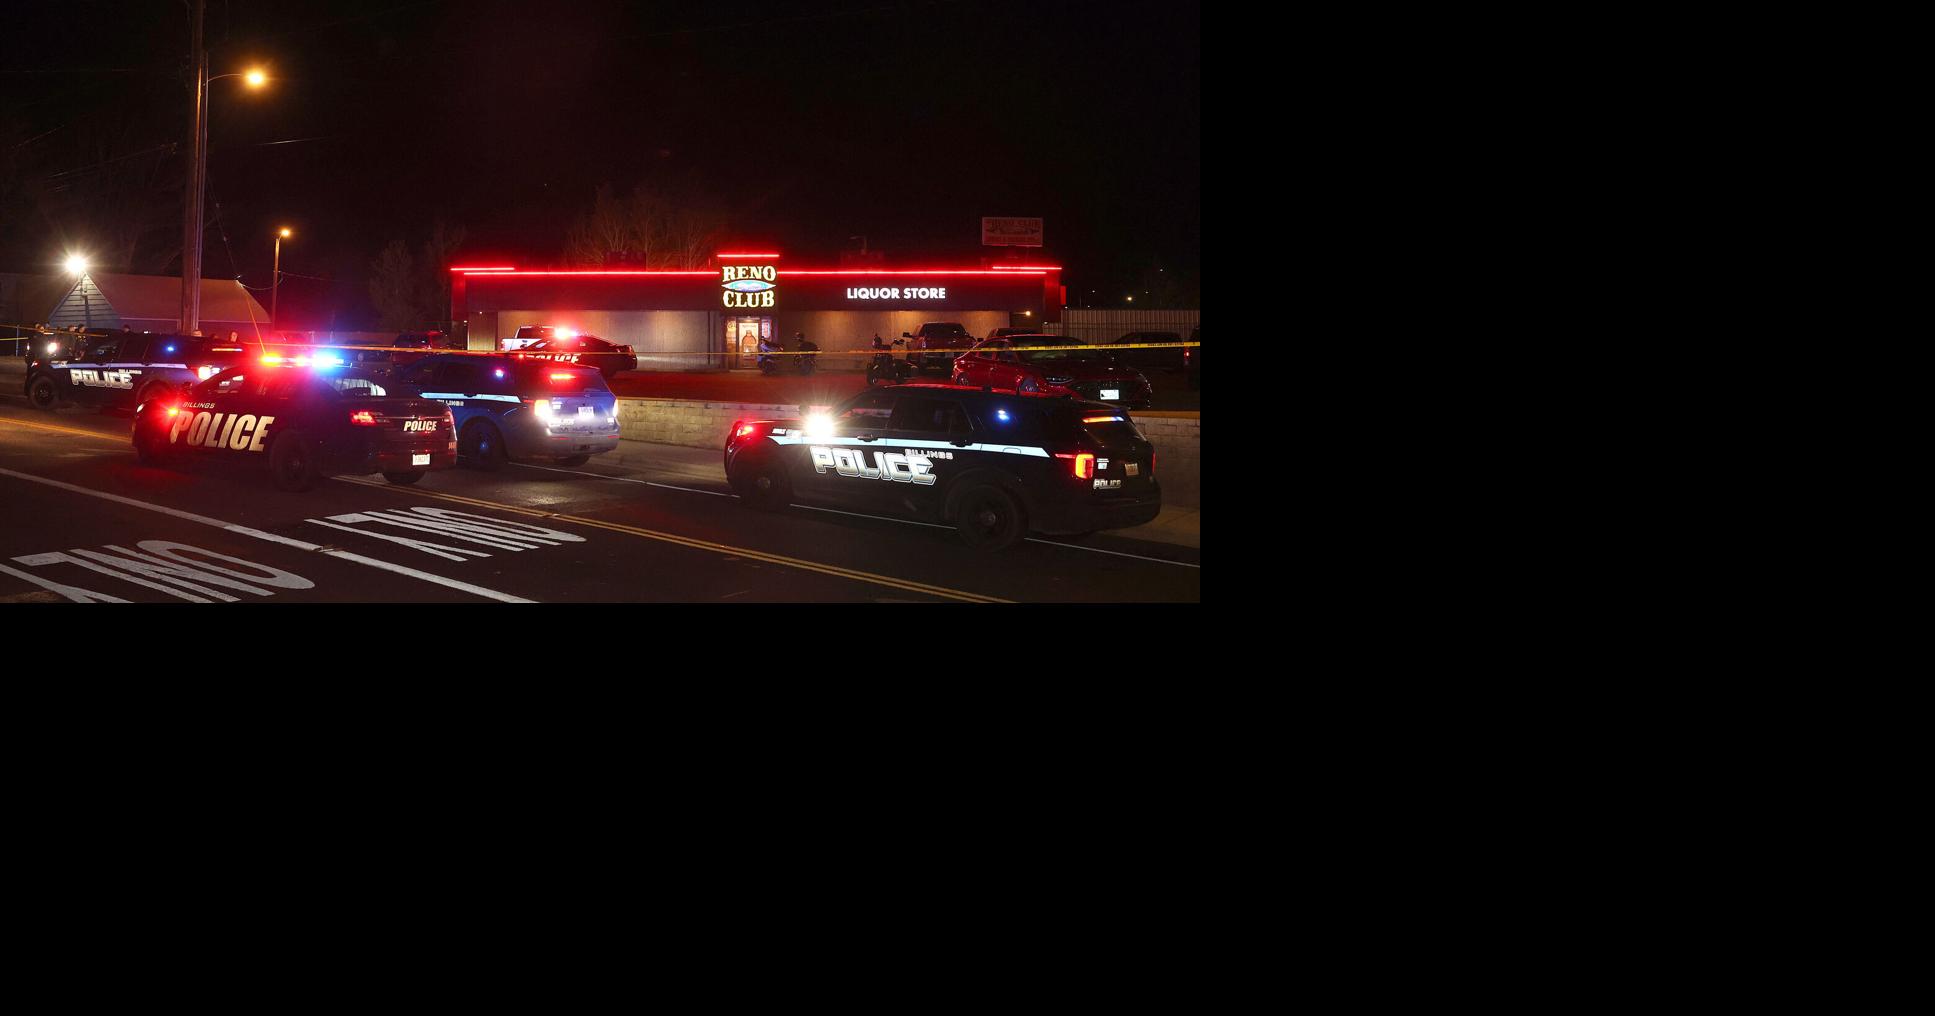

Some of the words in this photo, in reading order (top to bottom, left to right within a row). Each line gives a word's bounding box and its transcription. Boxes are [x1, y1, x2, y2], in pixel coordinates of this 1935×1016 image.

[722, 265, 776, 282] RENO
[723, 290, 775, 308] CLUB
[847, 287, 900, 300] LIQUOR
[903, 287, 946, 300] STORE
[70, 369, 134, 389] POLICE
[169, 410, 275, 452] POLICE
[403, 420, 437, 432] POLICE
[809, 446, 937, 486] POLICE
